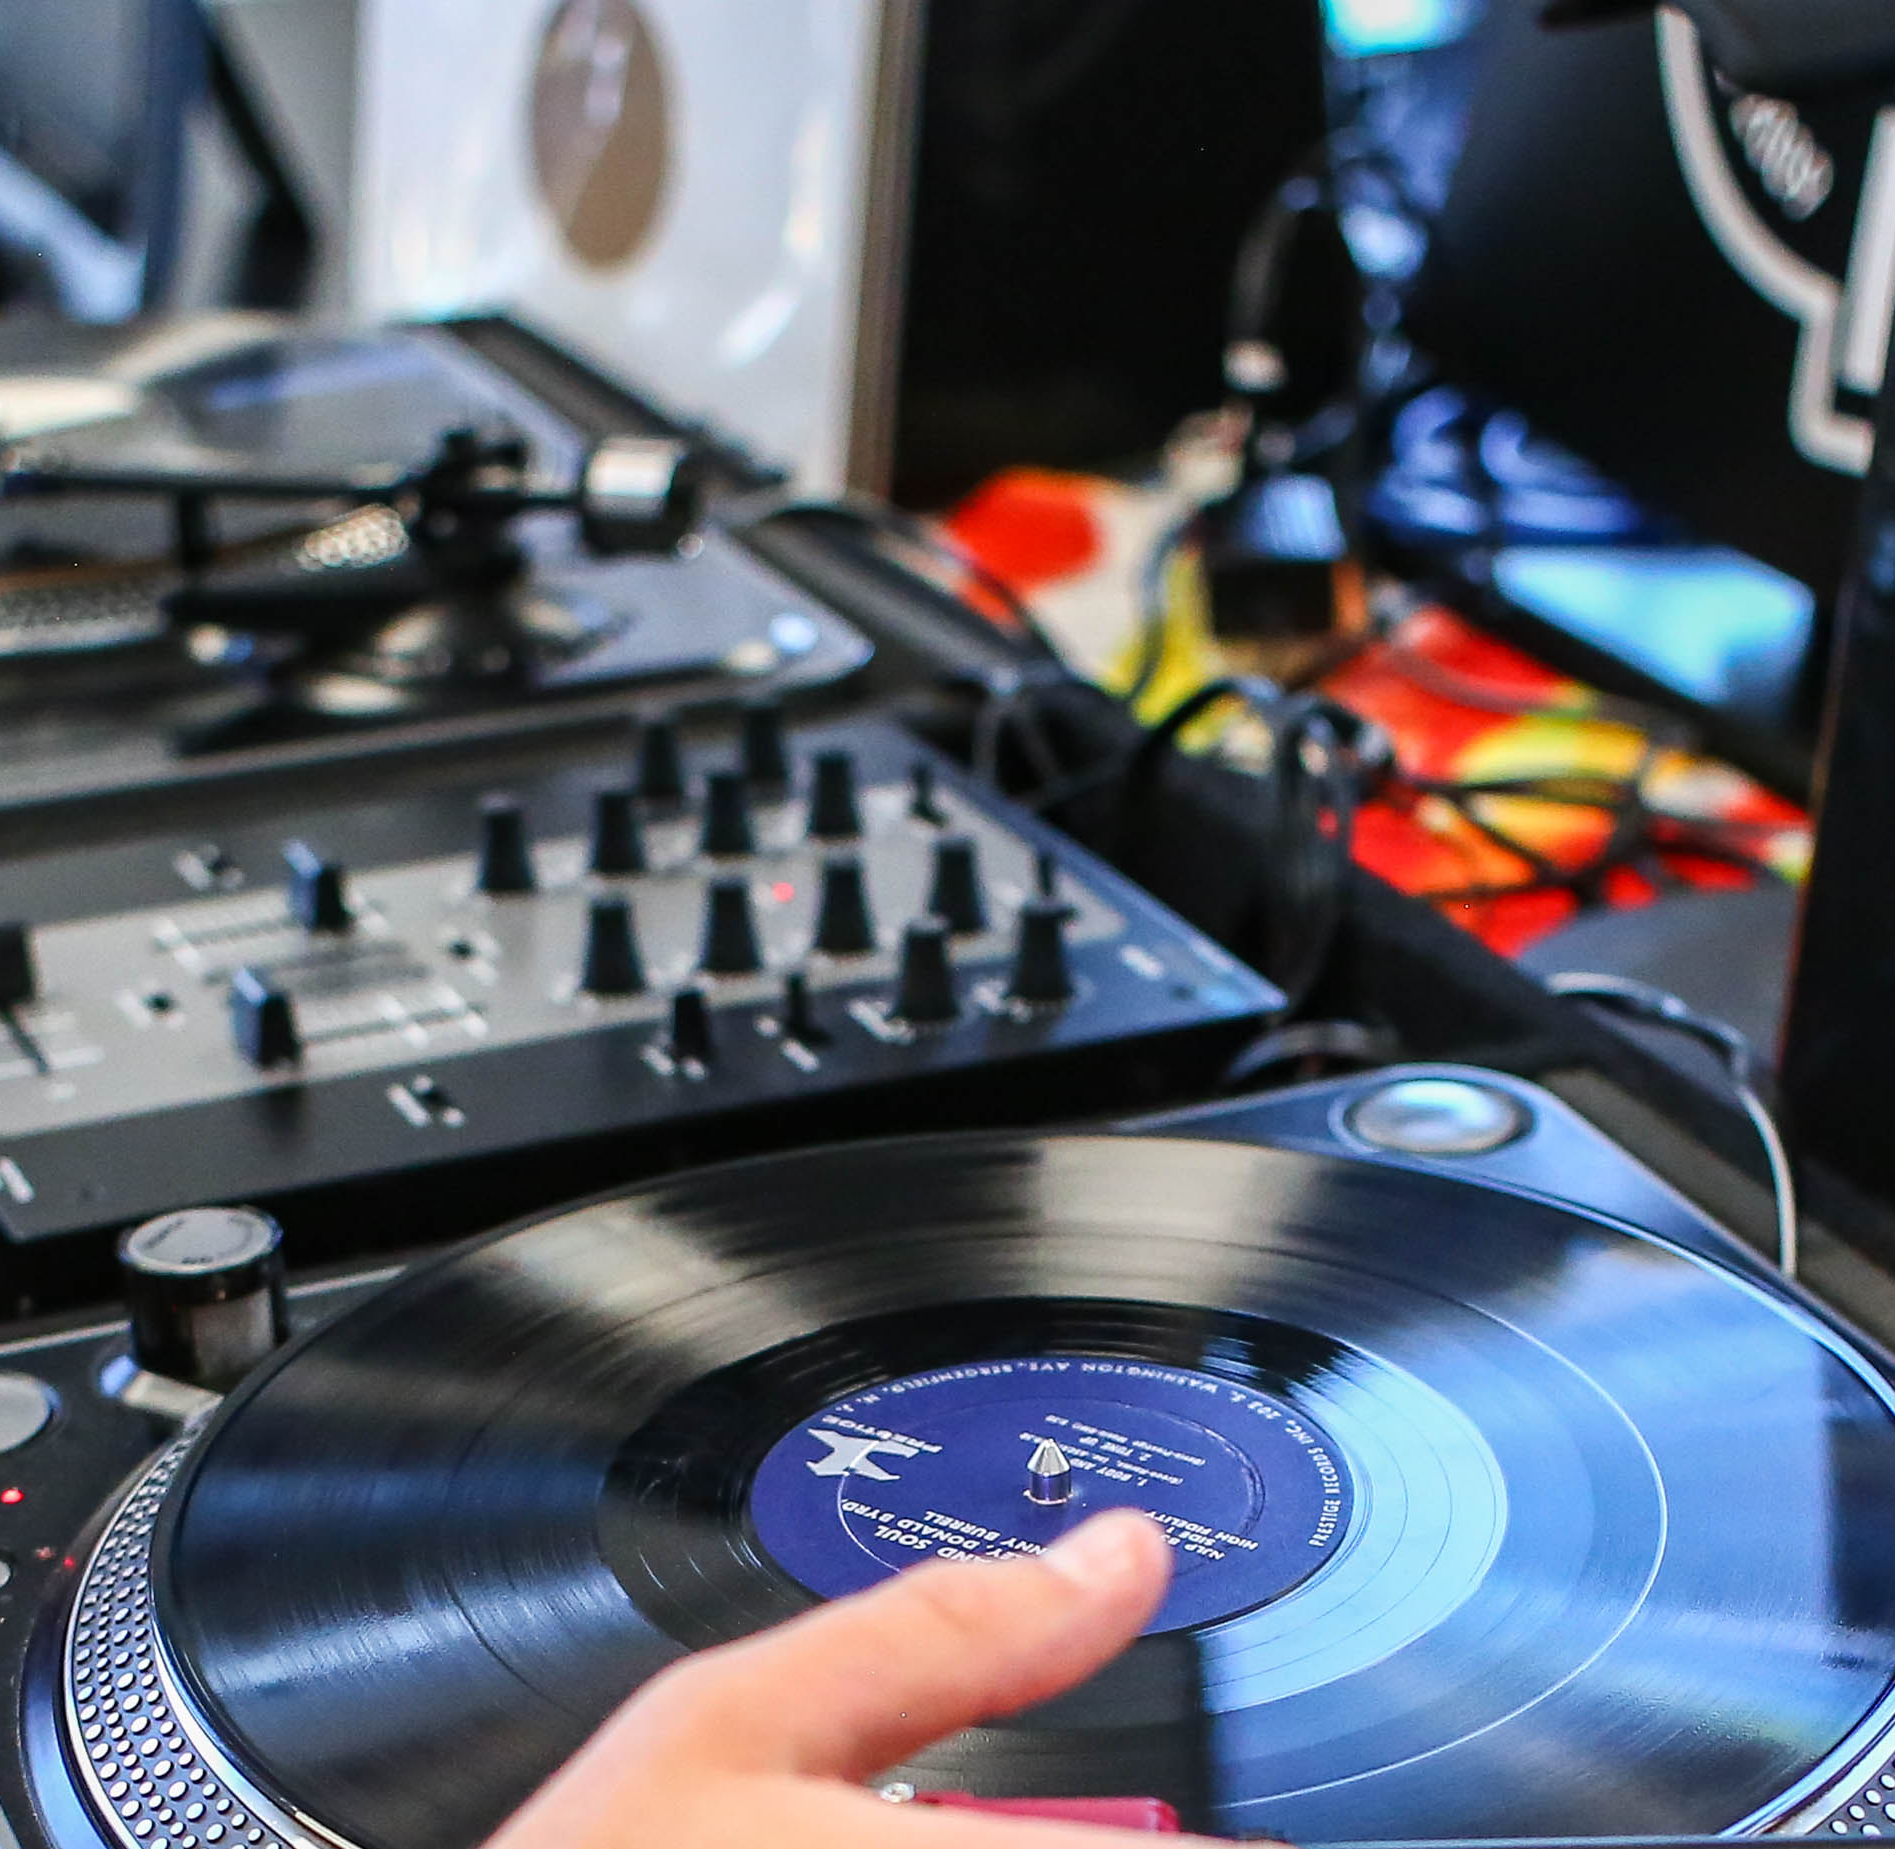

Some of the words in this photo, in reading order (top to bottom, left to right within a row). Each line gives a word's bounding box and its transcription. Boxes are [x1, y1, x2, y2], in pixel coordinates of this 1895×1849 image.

[1081, 1362, 1220, 1394] WASHINGTON
[822, 1414, 942, 1455] PRESTIGE
[1096, 1466, 1132, 1482] BODY
[1307, 1448, 1341, 1494] RECORDS
[875, 1524, 932, 1550] SOUL
[898, 1517, 980, 1550] DONALD
[924, 1511, 1000, 1541] BURRELL
[1144, 1511, 1212, 1535] FIDELITY
[1308, 1499, 1341, 1547] PRESTIGE
[1179, 1531, 1215, 1546] SIDE
[1184, 1544, 1225, 1560] NJLP
[1215, 1531, 1258, 1550] HIGH
